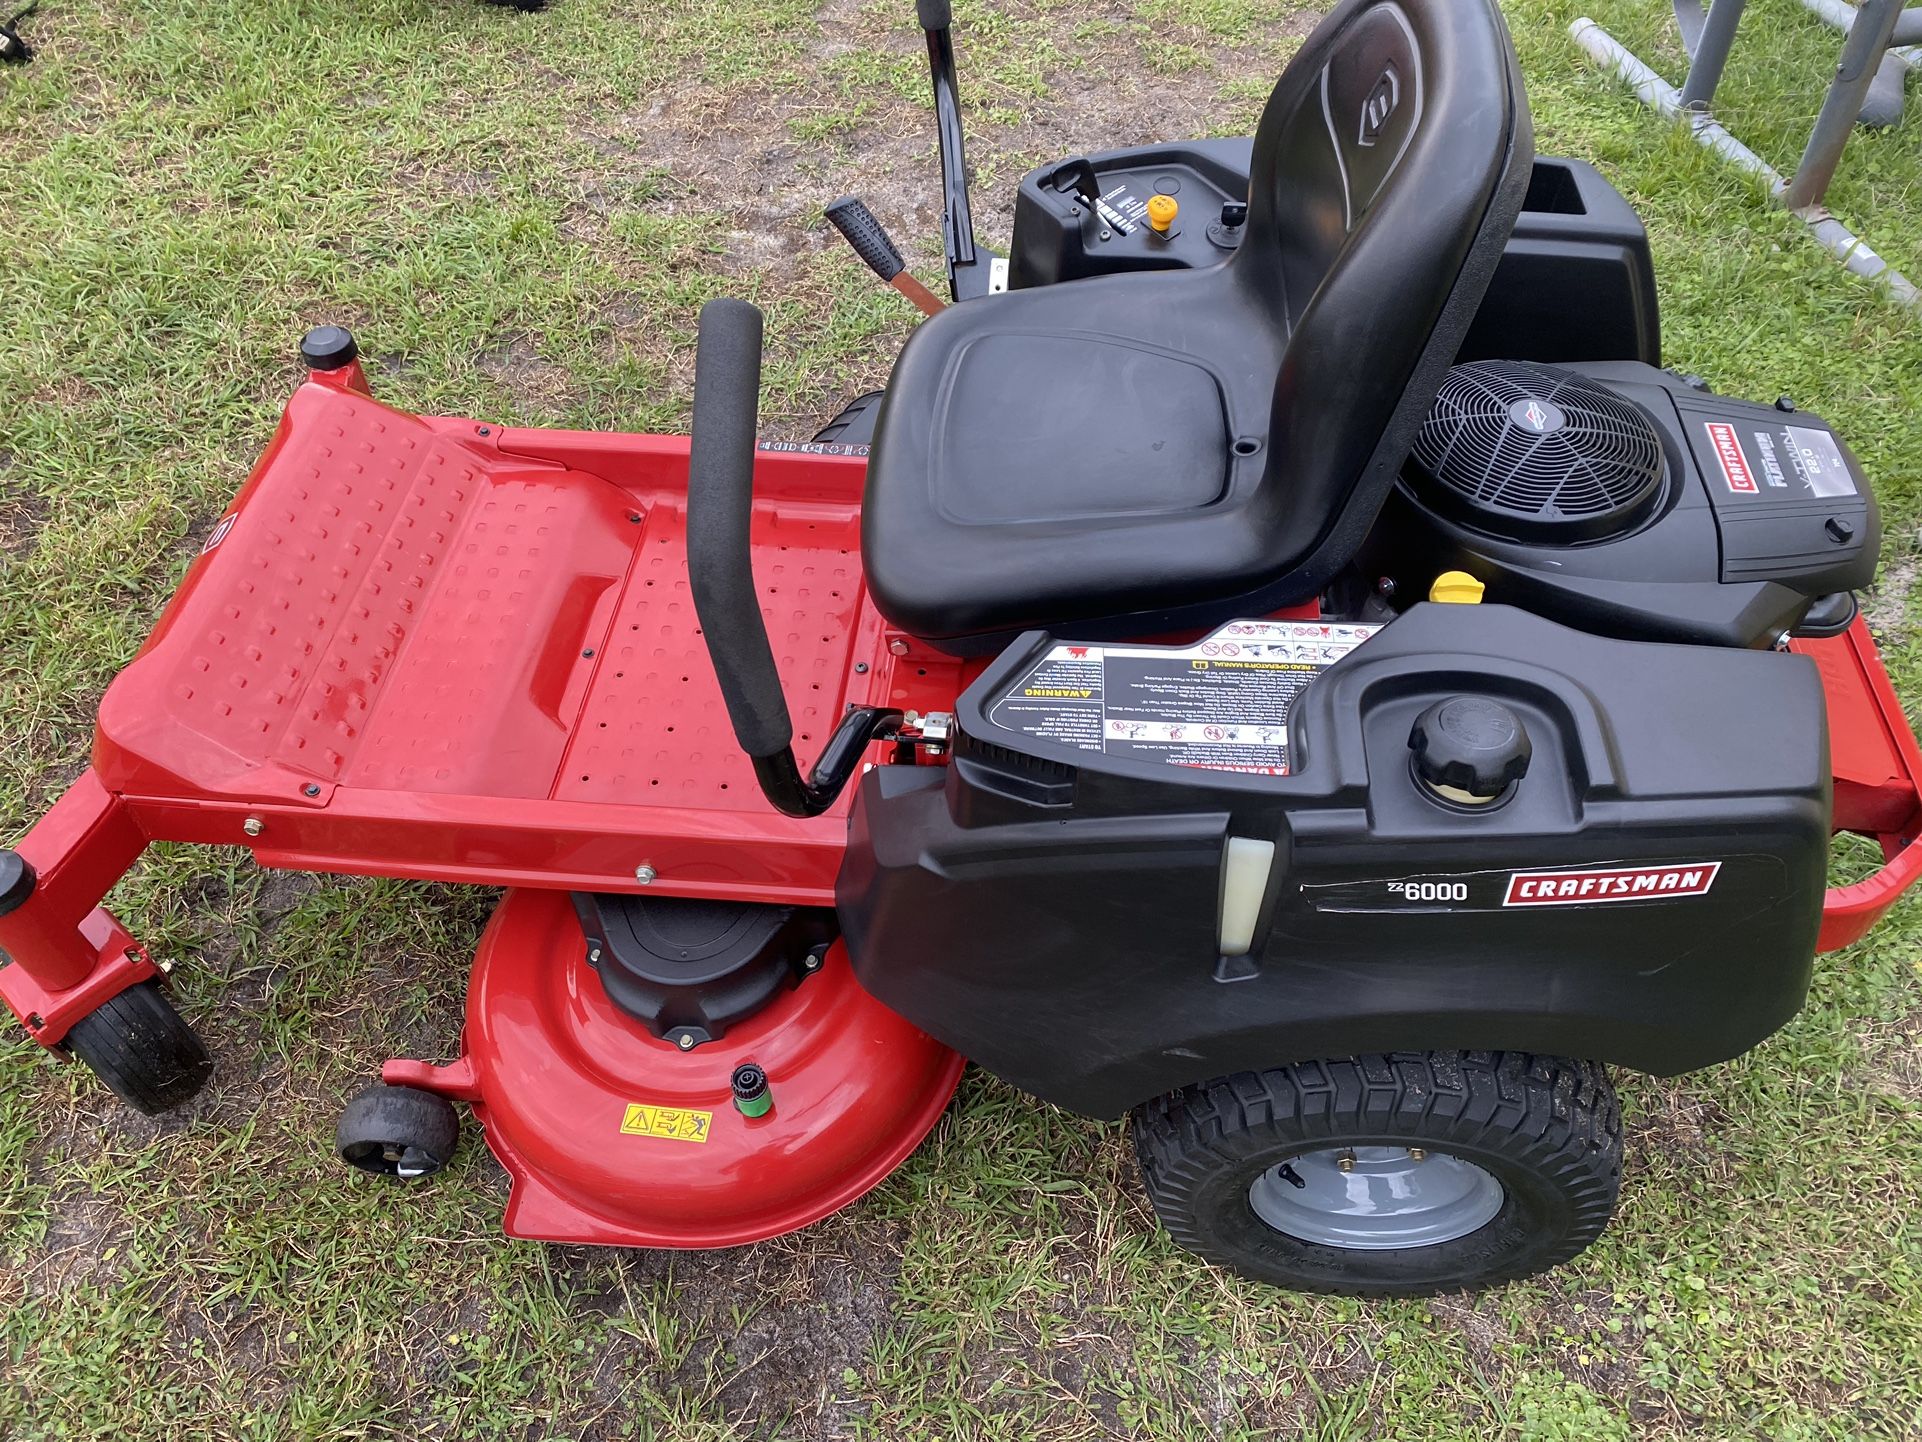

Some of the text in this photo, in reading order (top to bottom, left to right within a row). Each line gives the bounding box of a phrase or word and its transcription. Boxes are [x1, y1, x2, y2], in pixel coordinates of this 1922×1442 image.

[1713, 426, 1750, 488] CRAFTSMAN
[1780, 432, 1811, 489] V-TWIN
[1802, 448, 1820, 474] 22.0
[1024, 688, 1080, 697] WARNING
[1519, 870, 1703, 898] CRAFTSMAN
